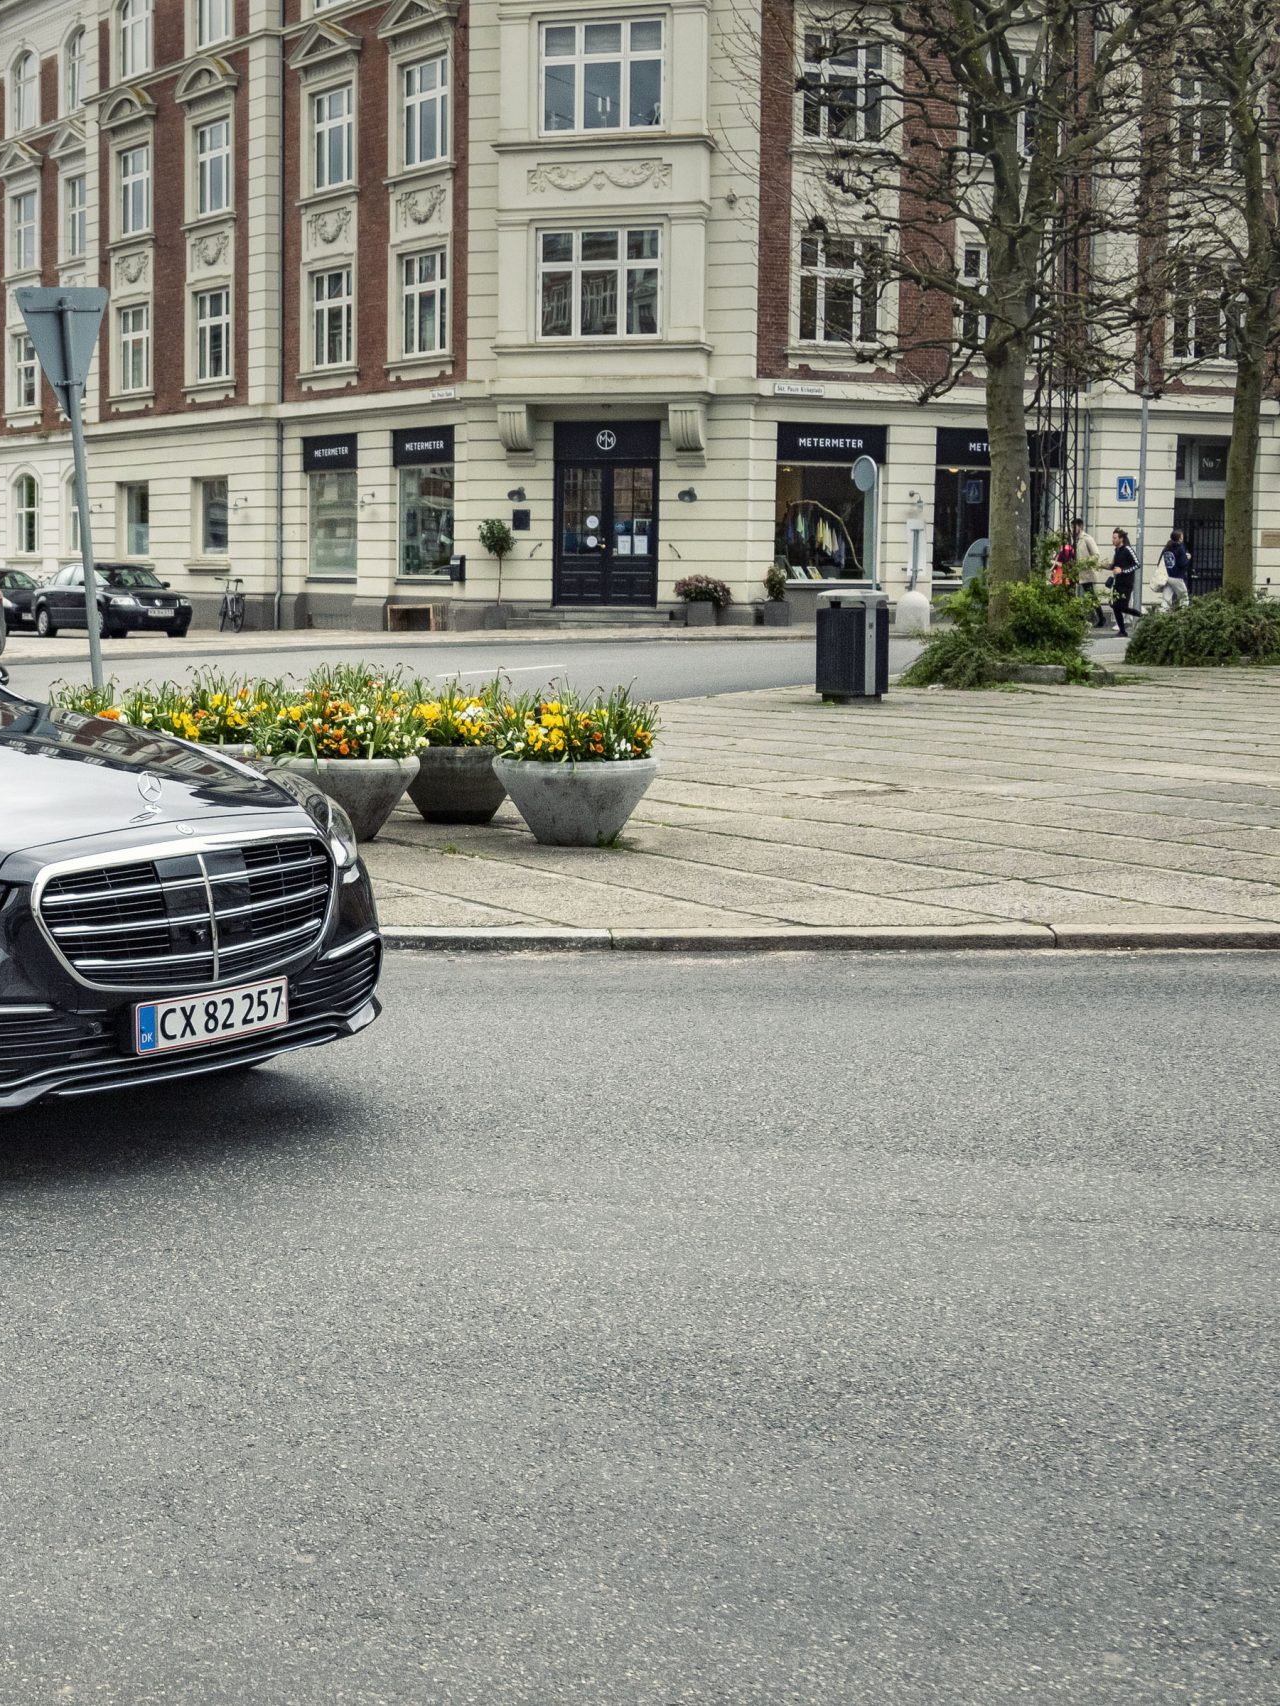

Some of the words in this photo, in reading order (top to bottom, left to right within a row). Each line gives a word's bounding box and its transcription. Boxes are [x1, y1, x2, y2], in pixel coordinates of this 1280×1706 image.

[405, 440, 444, 451] METERMETER
[798, 438, 864, 448] METERMETER
[314, 446, 349, 457] METERMETER
[1215, 459, 1221, 469] 7
[160, 1004, 196, 1041] CX
[204, 998, 235, 1034] 82
[242, 986, 284, 1026] 257
[141, 1031, 153, 1044] DK
